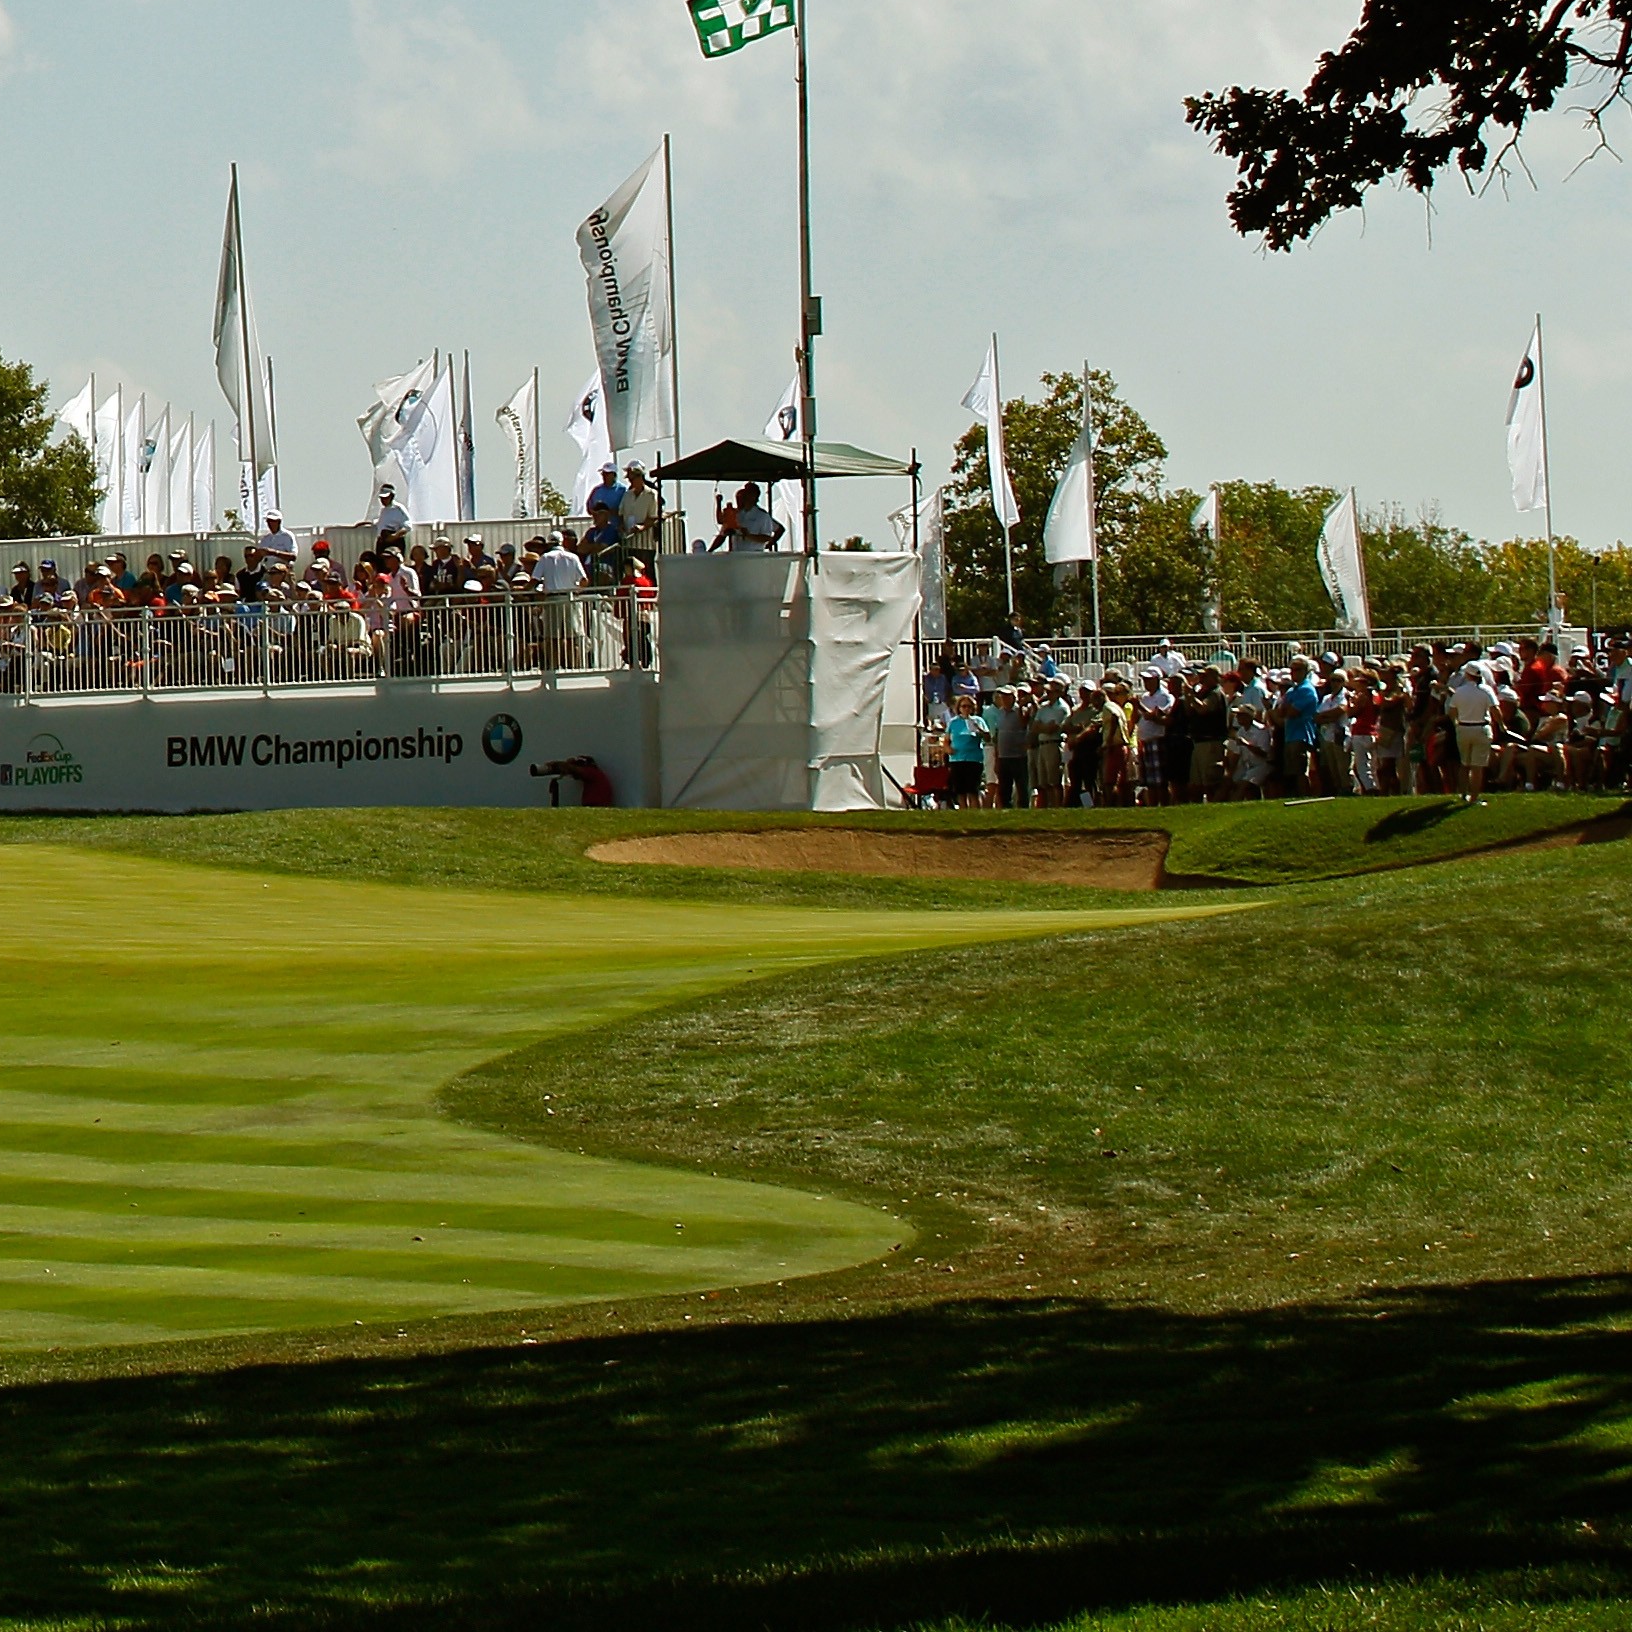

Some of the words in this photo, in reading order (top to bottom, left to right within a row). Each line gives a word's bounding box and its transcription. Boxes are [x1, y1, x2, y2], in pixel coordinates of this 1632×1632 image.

[167, 735, 246, 767] BMW
[251, 726, 463, 769] Championship
[16, 764, 83, 786] PLAYOFFS
